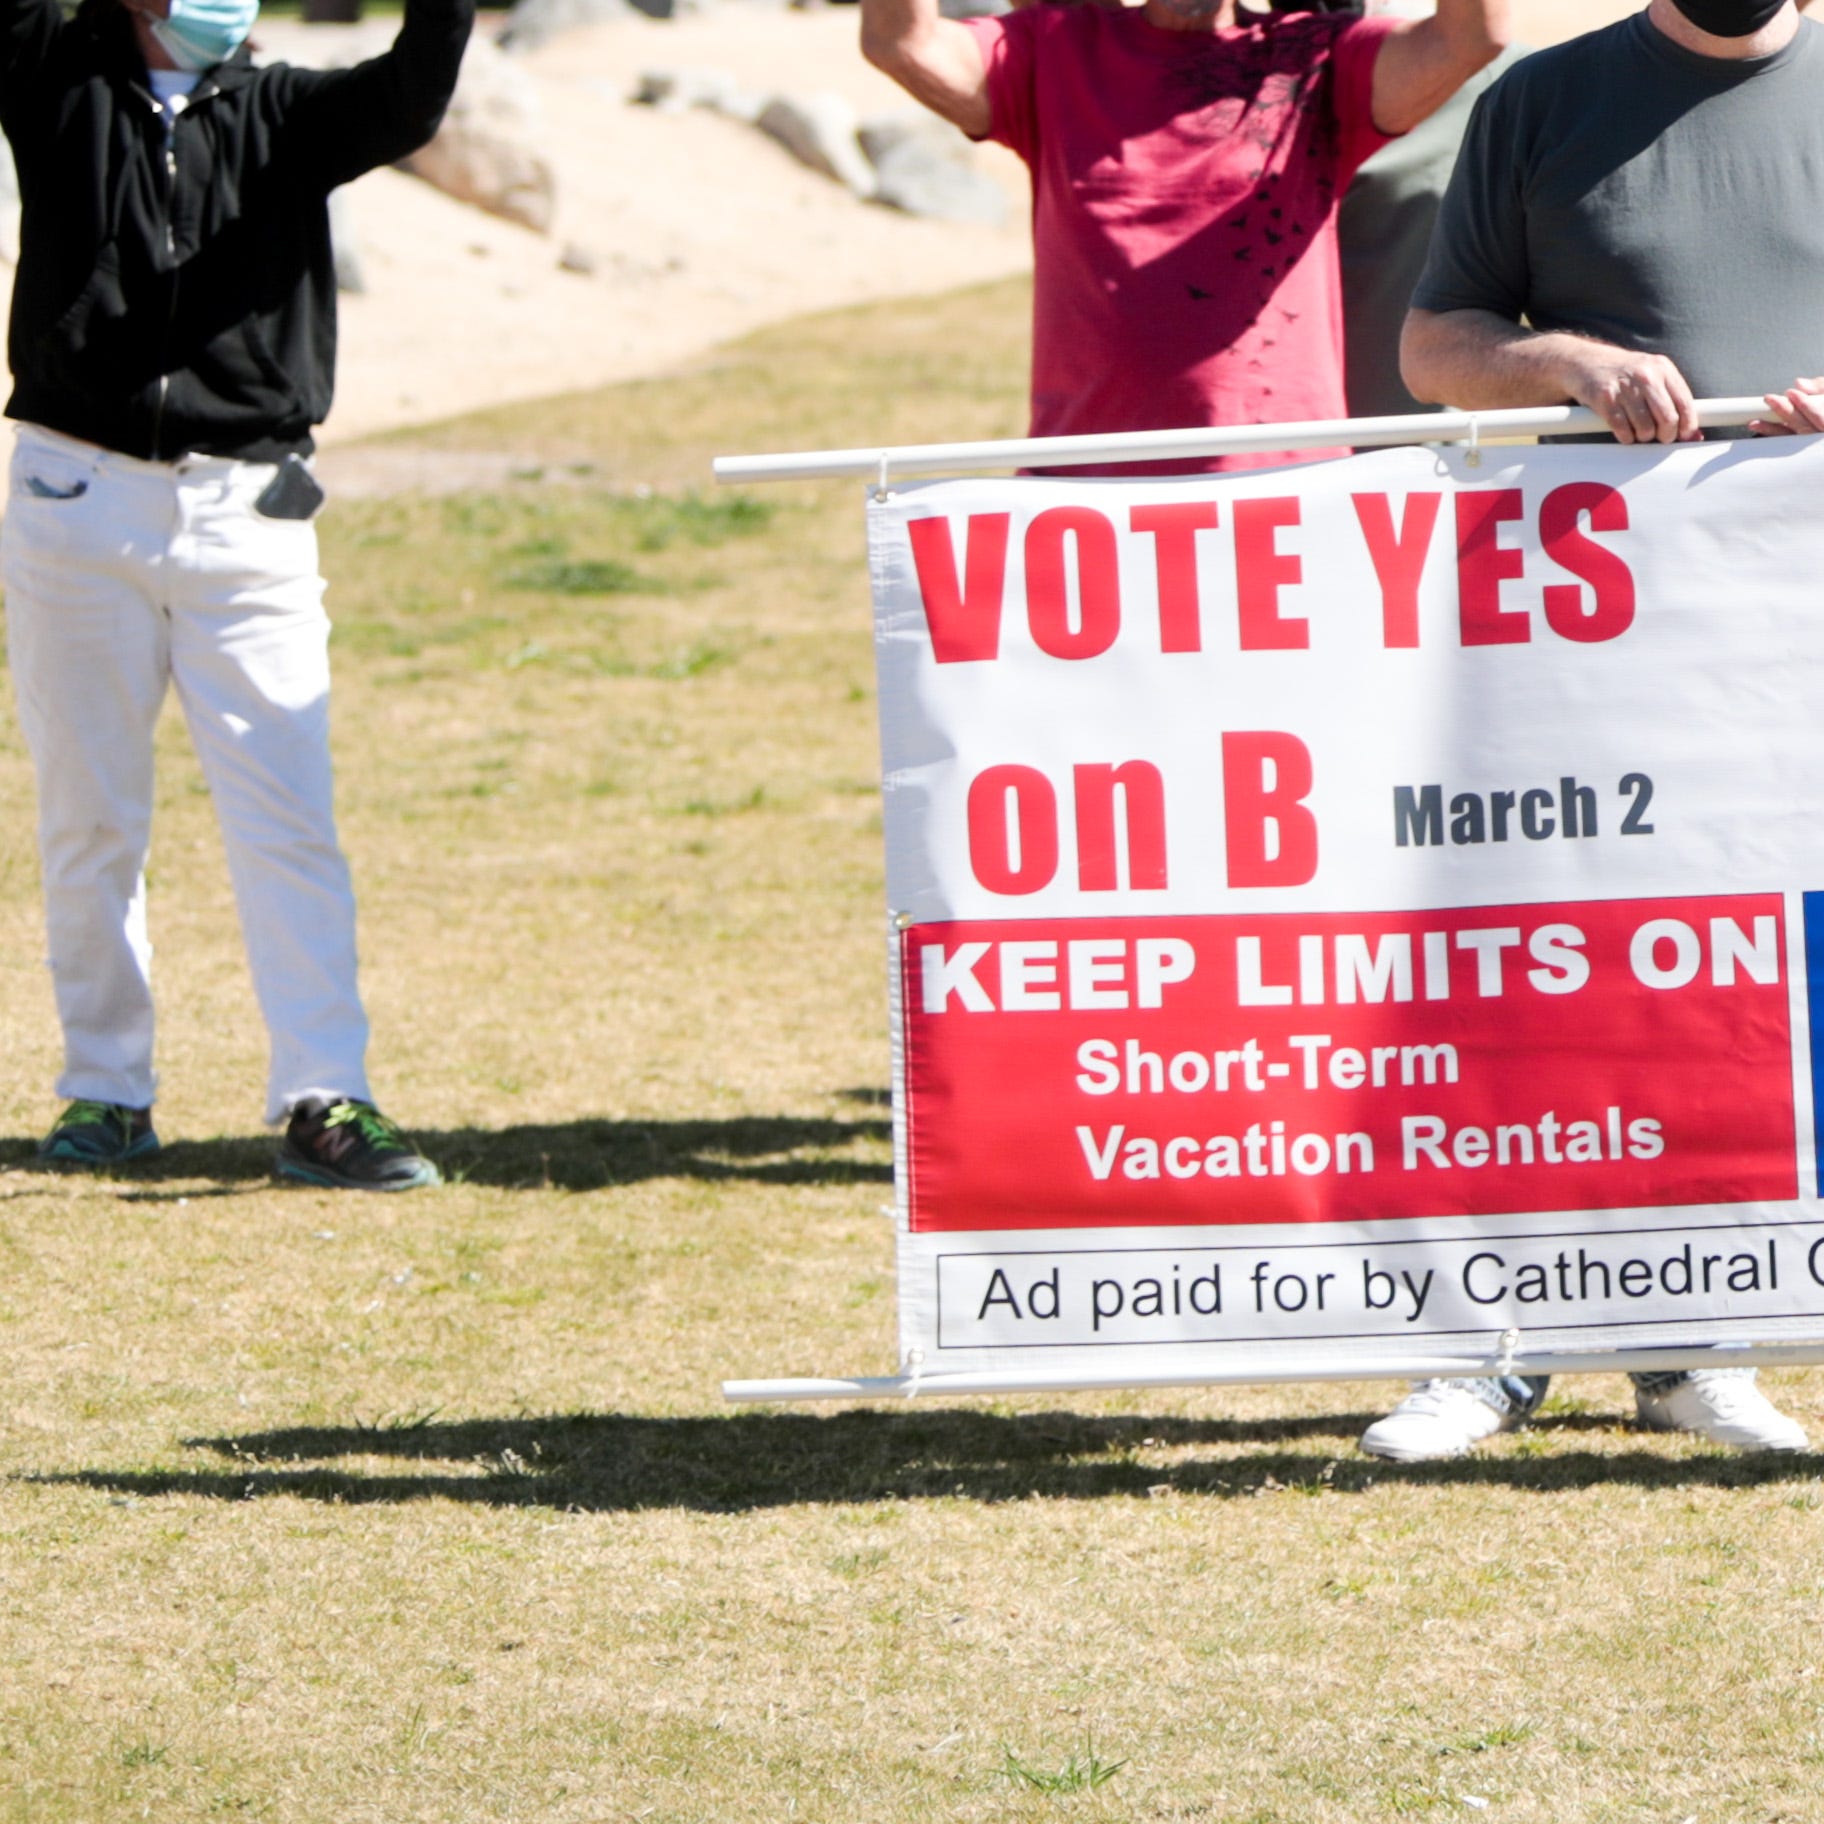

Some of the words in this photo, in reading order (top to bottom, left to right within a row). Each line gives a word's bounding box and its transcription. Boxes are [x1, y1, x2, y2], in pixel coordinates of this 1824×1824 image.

[907, 495, 1310, 665] VOTE
[1350, 480, 1636, 650] YES
[966, 758, 1169, 897] on
[1220, 730, 1319, 890] B
[1392, 776, 1599, 848] March
[1618, 772, 1655, 837] 2
[920, 936, 1197, 1014] KEEP
[1235, 922, 1591, 1009] LIMITS
[1628, 914, 1780, 991] ON
[1075, 1034, 1460, 1094] Short-Term
[1076, 1122, 1374, 1180] Vacation
[1402, 1105, 1665, 1170] Rentals
[978, 1266, 1061, 1321] Ad
[1092, 1262, 1223, 1331] paid
[1251, 1260, 1336, 1315] for
[1362, 1258, 1434, 1322] by
[1461, 1237, 1778, 1305] Cathedral
